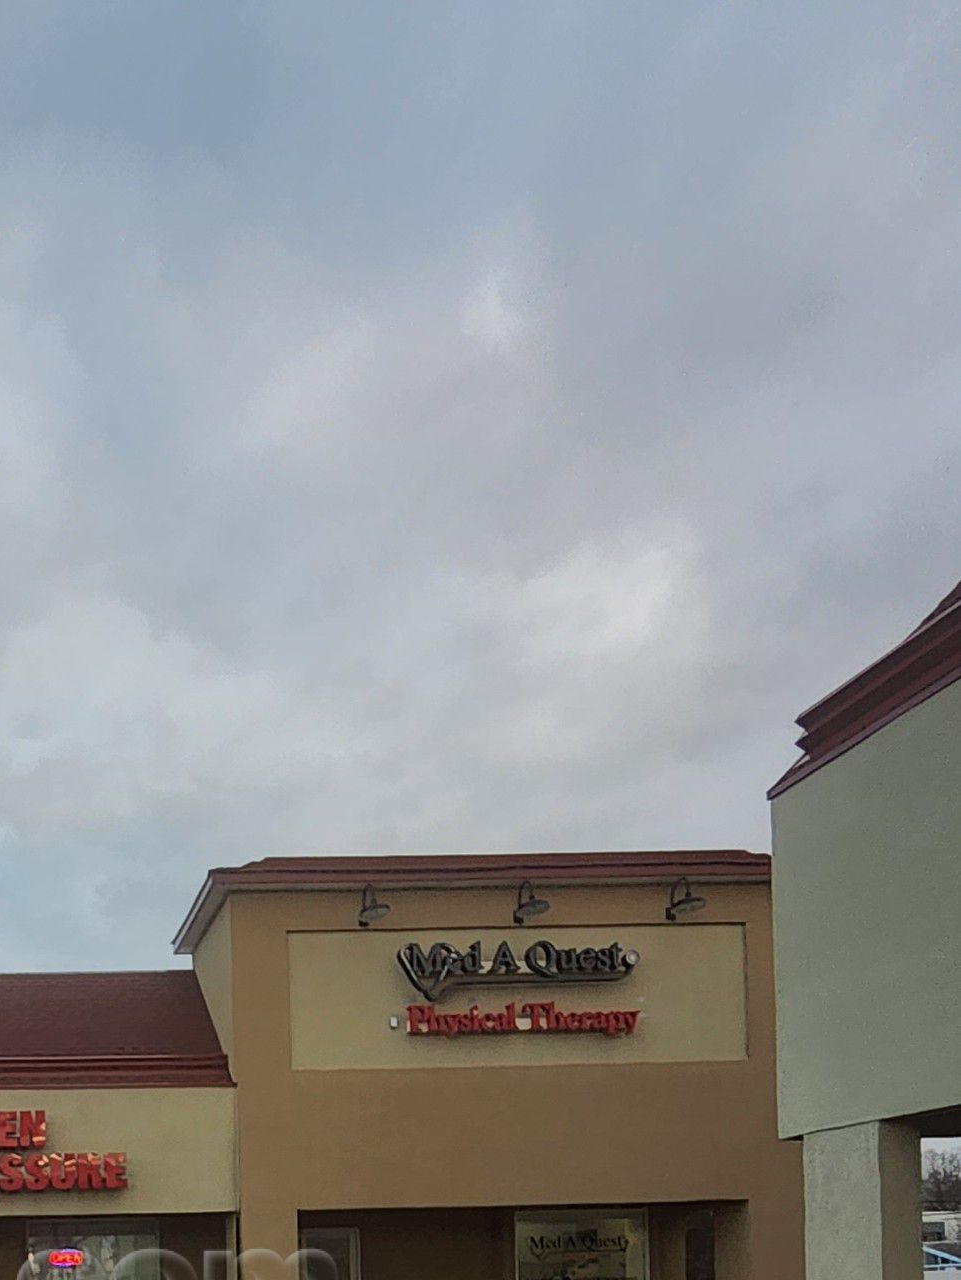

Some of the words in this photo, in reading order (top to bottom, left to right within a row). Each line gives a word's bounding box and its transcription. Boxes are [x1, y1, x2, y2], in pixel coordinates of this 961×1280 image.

[410, 940, 481, 975] Med
[491, 940, 521, 974] A
[524, 939, 623, 978] Quest
[406, 1002, 517, 1037] Physical
[522, 1001, 641, 1037] Therapy
[49, 1252, 83, 1265] OPEN
